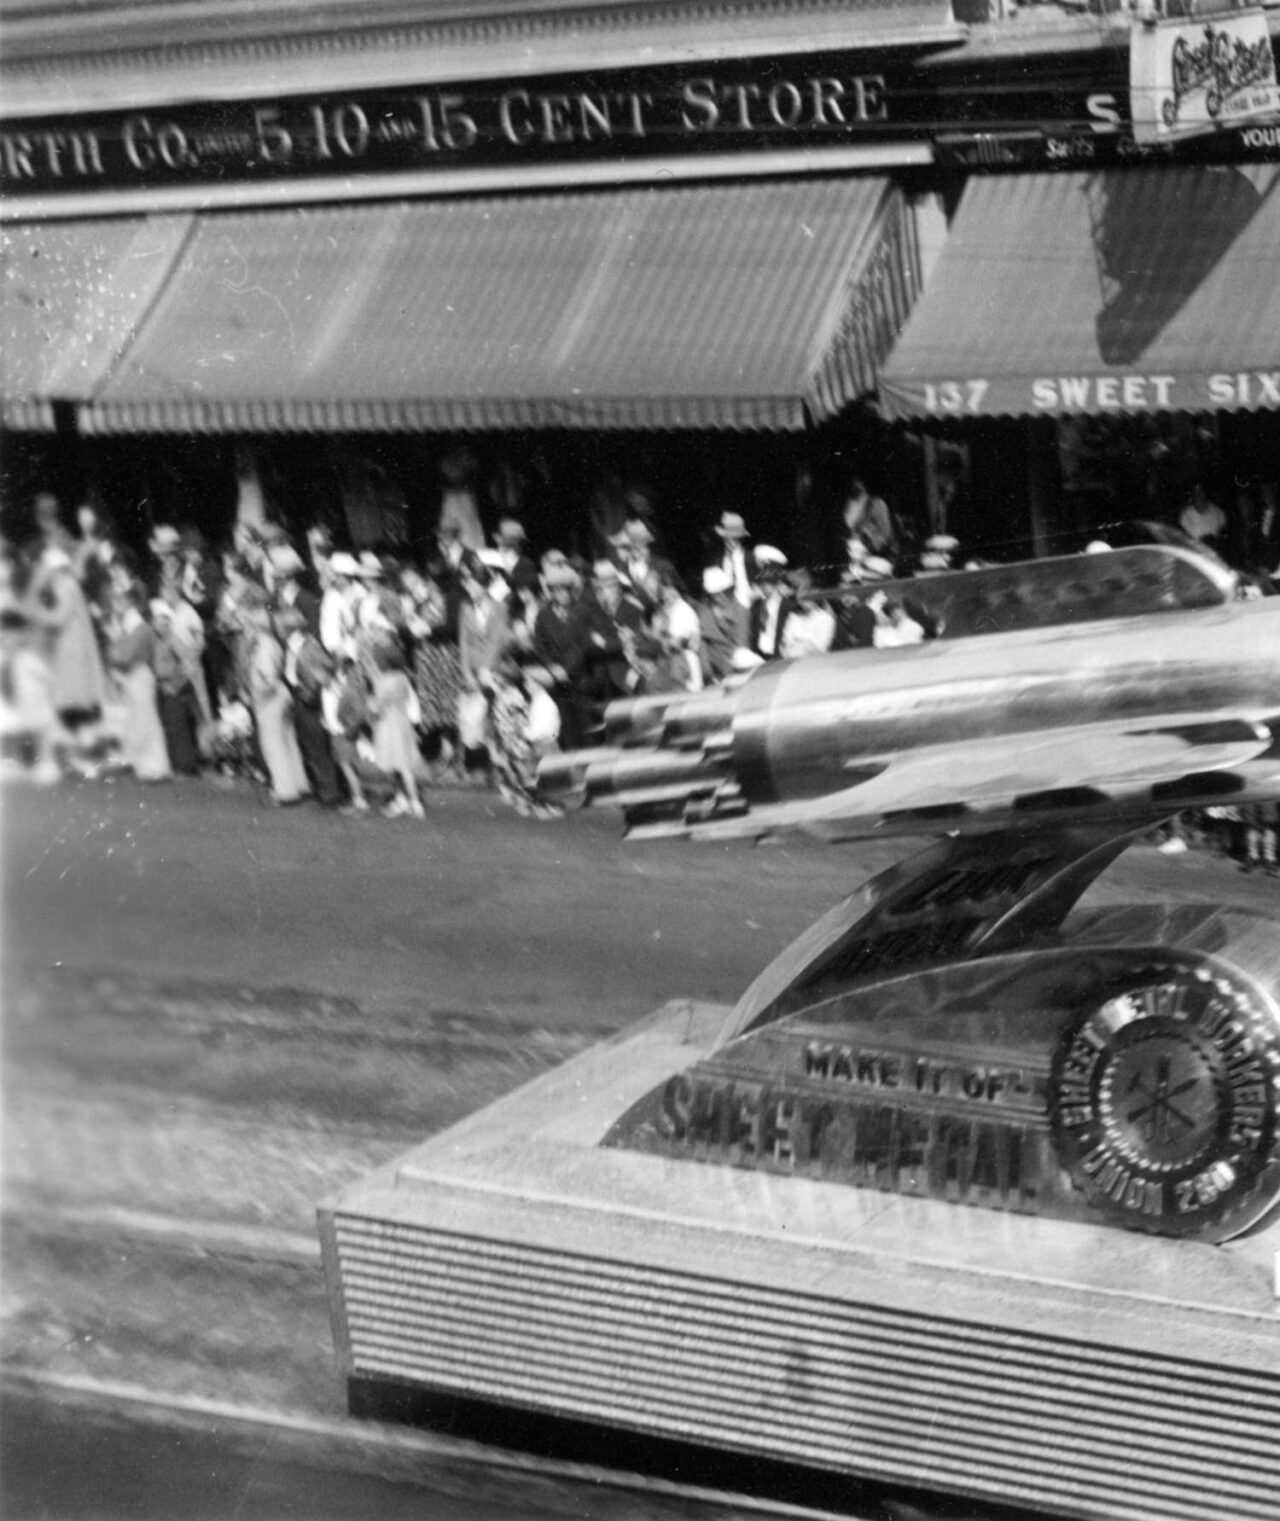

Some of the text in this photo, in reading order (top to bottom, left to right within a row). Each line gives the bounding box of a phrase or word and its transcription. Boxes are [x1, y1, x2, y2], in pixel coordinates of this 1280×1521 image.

[0, 130, 104, 178] RTH
[500, 90, 653, 145] CENT
[682, 74, 888, 131] STORE
[923, 378, 989, 412] 137
[1031, 376, 1176, 408] SWEET
[804, 1039, 900, 1087] MAKE
[915, 1056, 947, 1094] IT
